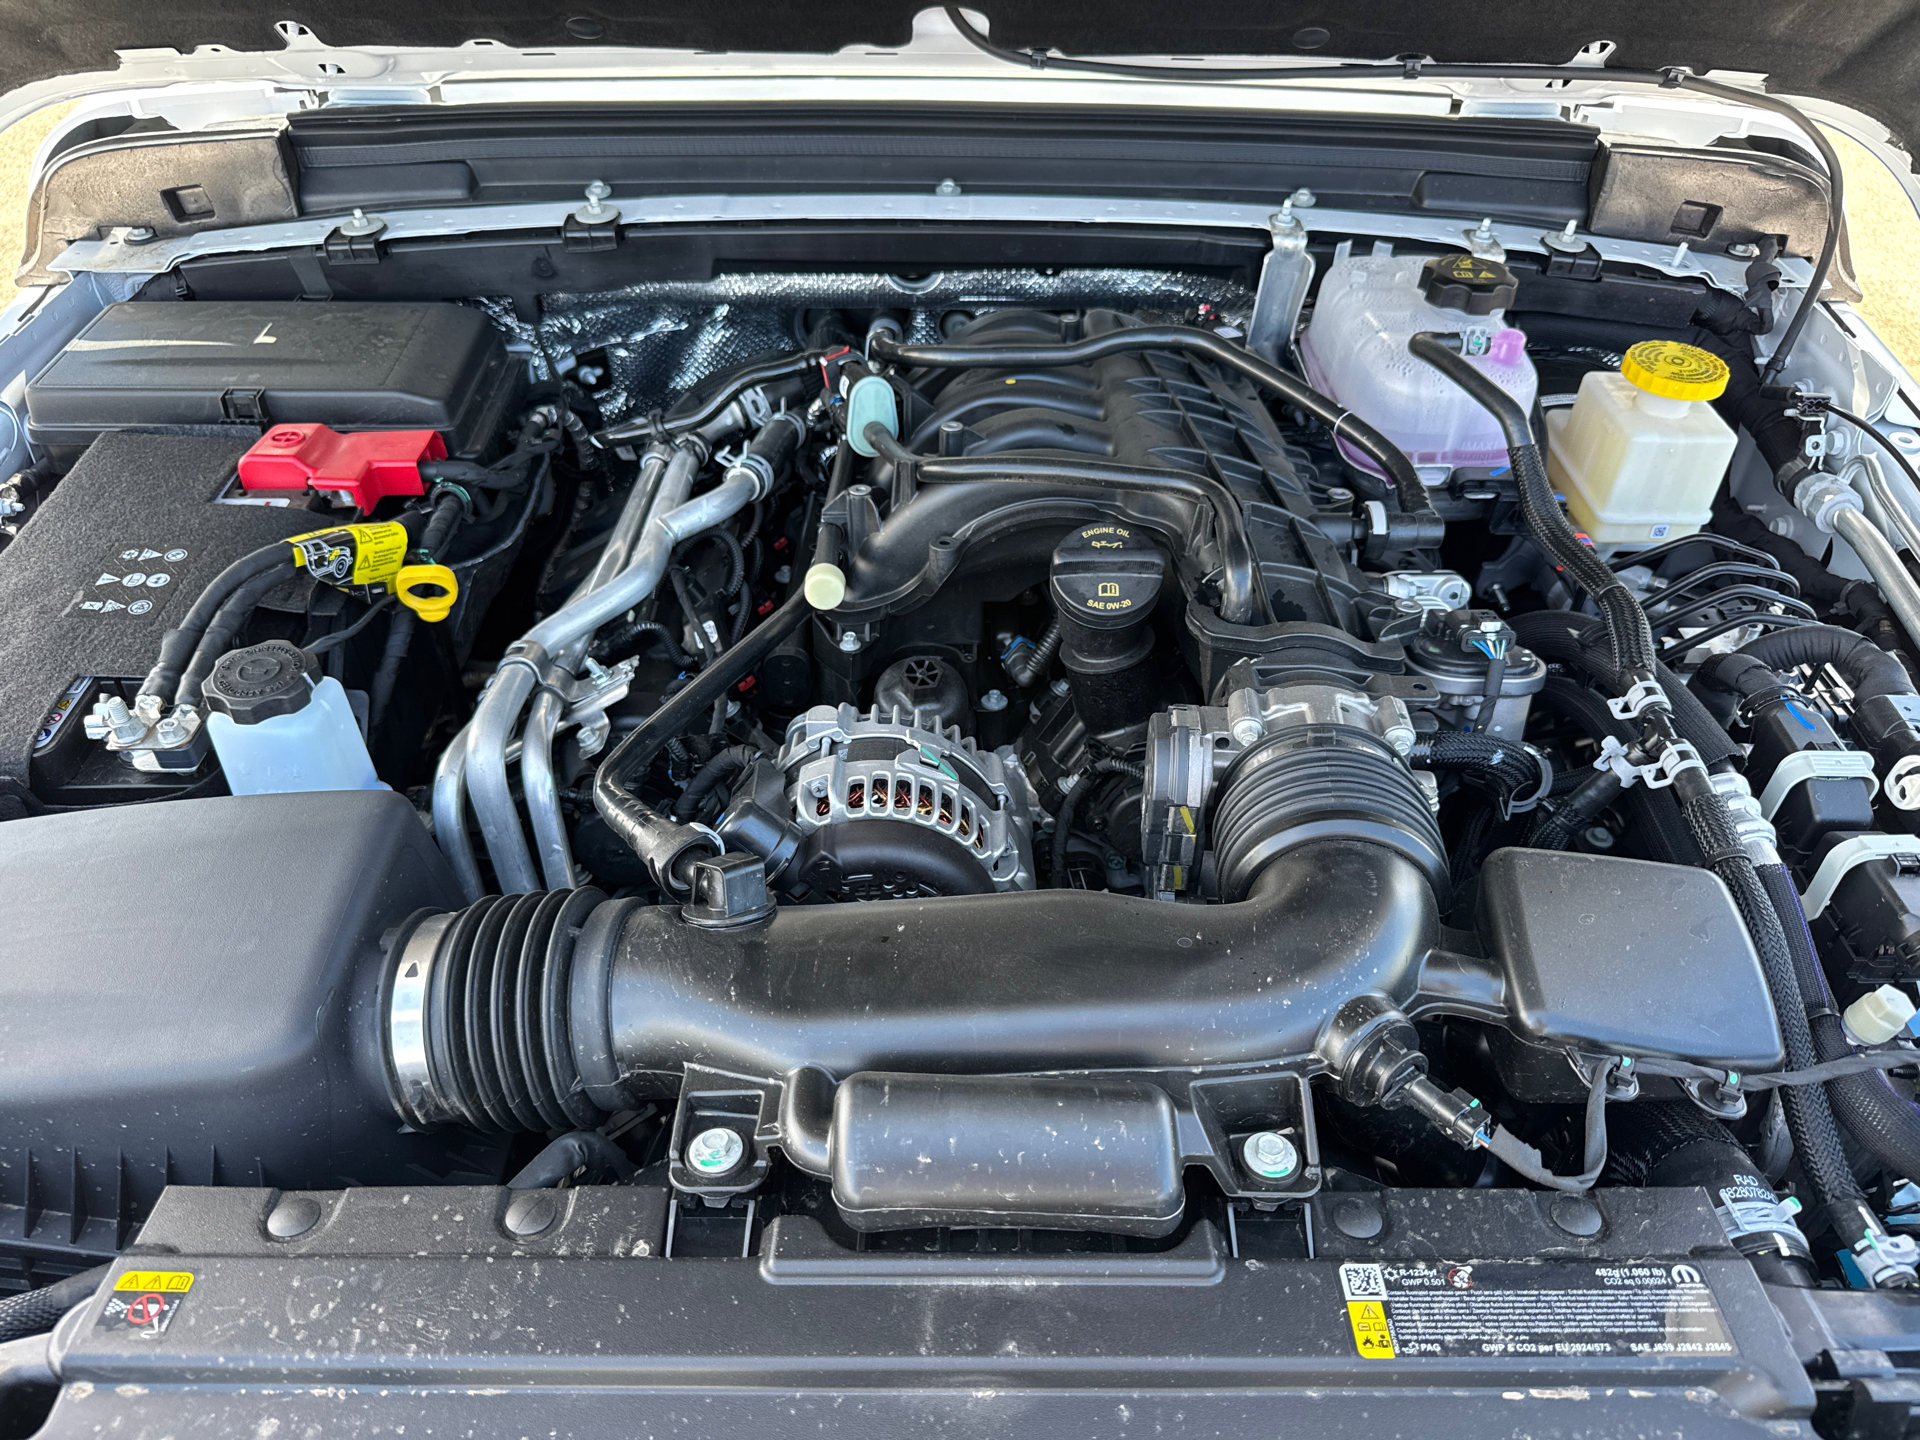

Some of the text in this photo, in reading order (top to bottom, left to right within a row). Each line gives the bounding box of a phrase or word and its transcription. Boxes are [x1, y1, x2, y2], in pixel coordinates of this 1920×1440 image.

[1081, 527, 1130, 539] ENGINE OIL
[1086, 599, 1132, 610] SAE 0W-20
[1733, 1174, 1759, 1187] RAD
[1401, 1277, 1446, 1286] GWP 0.501
[1603, 1277, 1623, 1286] CO2
[1420, 1343, 1441, 1352] PAG
[1482, 1343, 1505, 1352] GWP
[1515, 1343, 1537, 1352] CO2
[1554, 1343, 1570, 1352] EU
[1629, 1342, 1651, 1352] SAE
